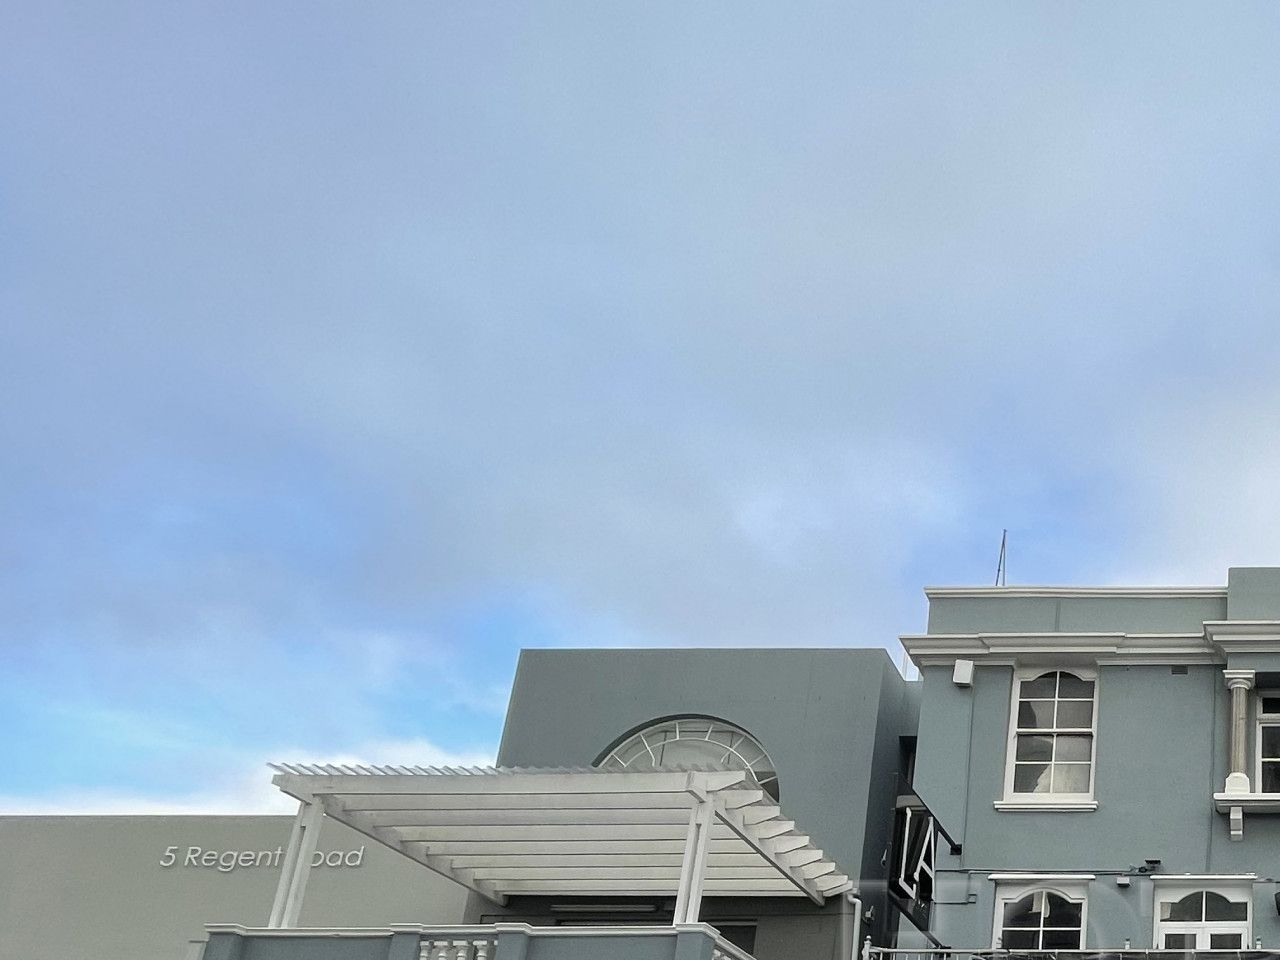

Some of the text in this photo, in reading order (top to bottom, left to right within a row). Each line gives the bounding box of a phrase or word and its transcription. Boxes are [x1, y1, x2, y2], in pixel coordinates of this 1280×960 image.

[159, 845, 366, 872] 5 Regent oad
